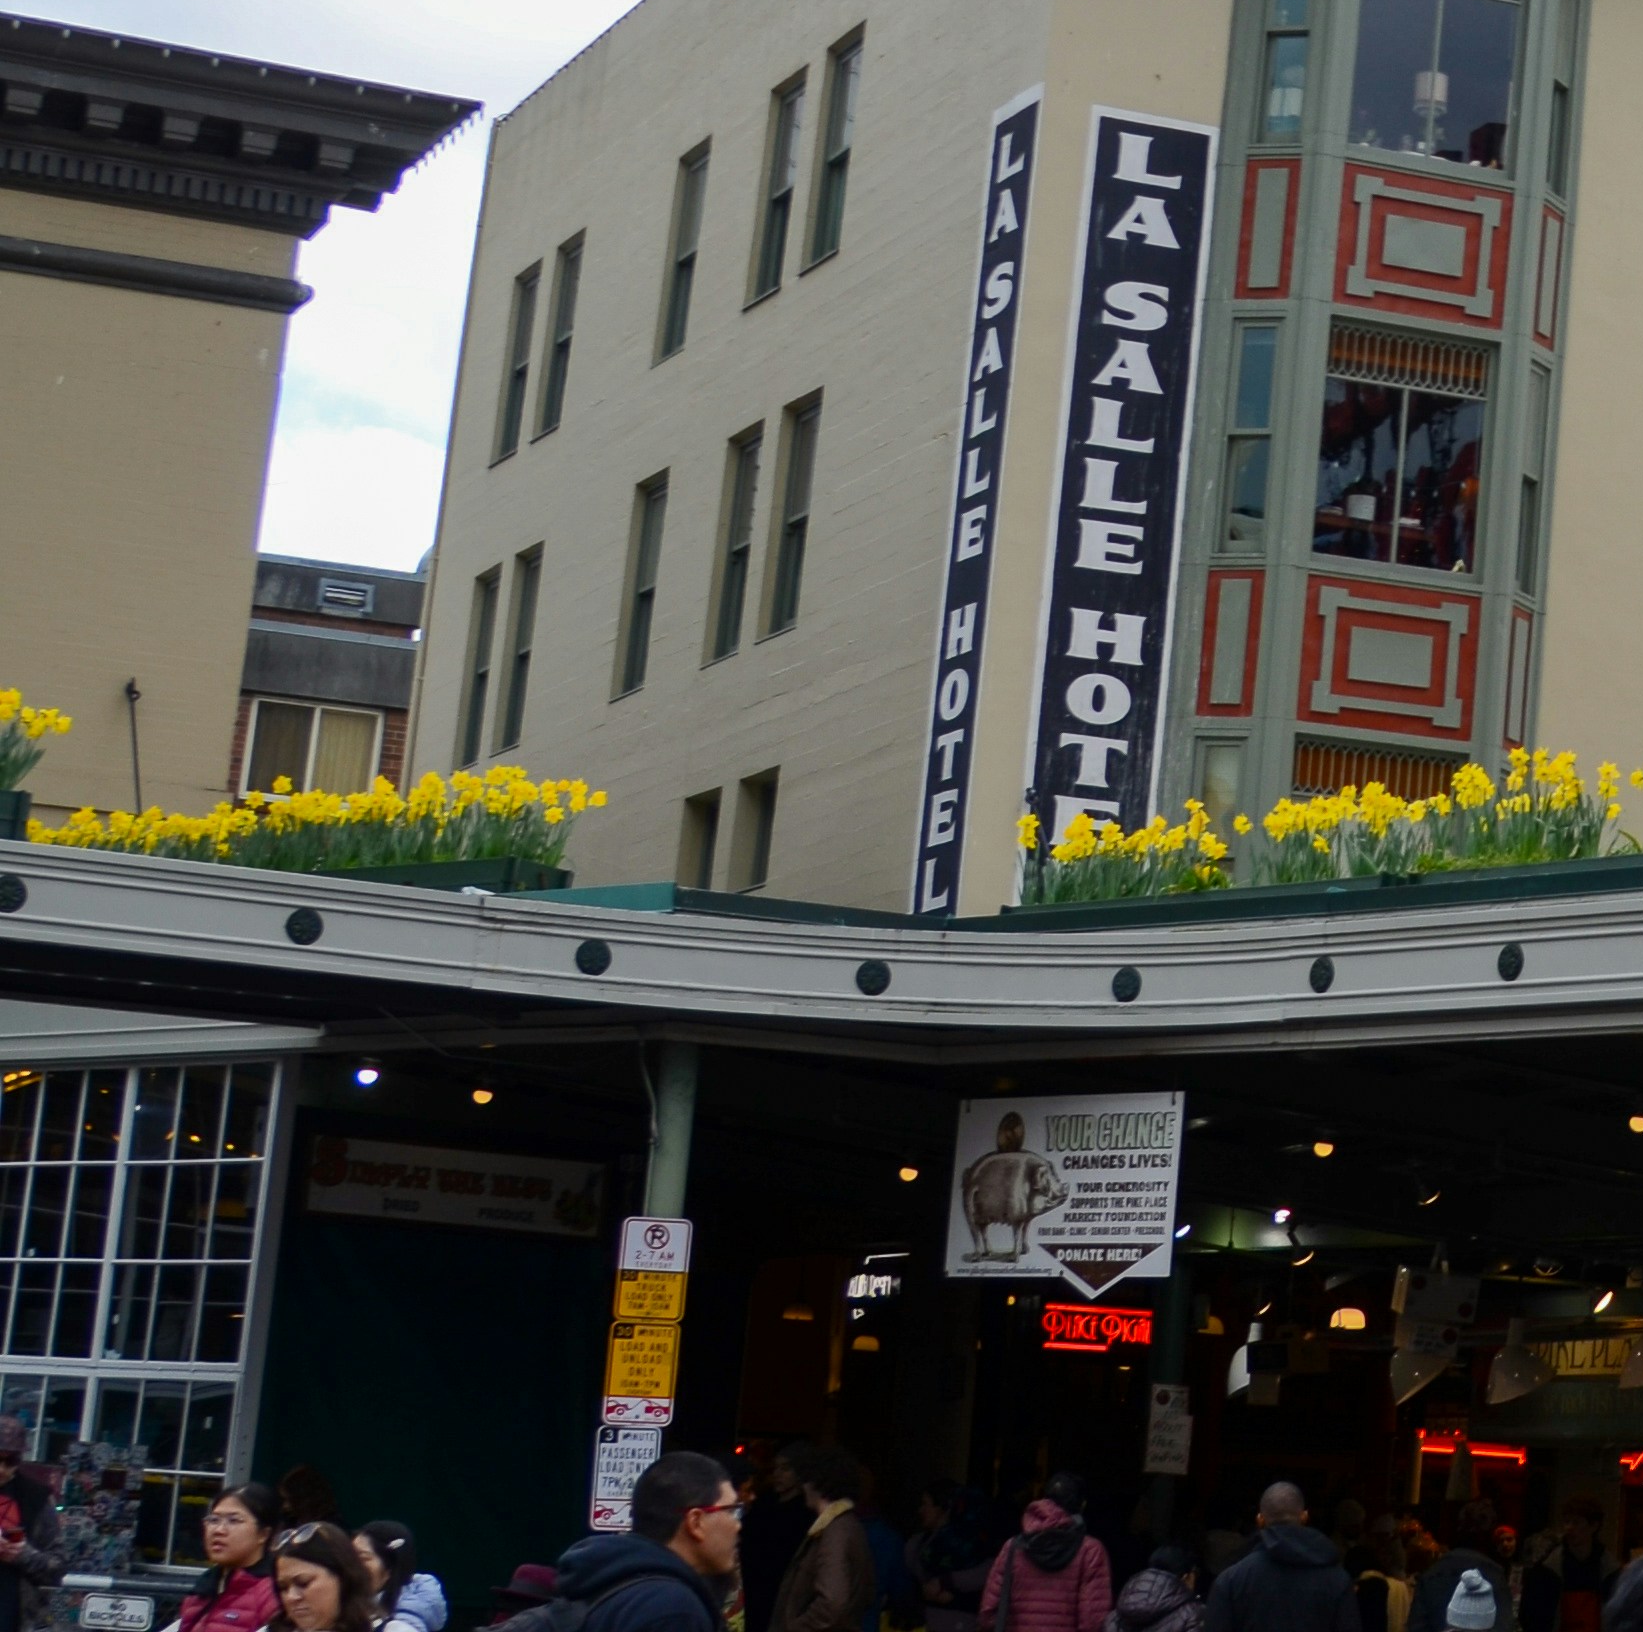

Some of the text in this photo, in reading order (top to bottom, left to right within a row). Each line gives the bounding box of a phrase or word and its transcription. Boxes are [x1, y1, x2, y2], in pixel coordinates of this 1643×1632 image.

[1050, 133, 1182, 846] LA SALLE HOTE
[921, 133, 1025, 913] LA SALLE HOTEL
[1046, 1111, 1177, 1152] YOUR CHANGE
[1063, 1154, 1172, 1169] CHANGES LIVES!
[1076, 1181, 1170, 1193] YOUR GENEROSITY
[1070, 1196, 1168, 1209] SUPPORTS THE PIKE PLACE
[1063, 1211, 1167, 1223] MARKET FOUNDATION
[1057, 1248, 1142, 1262] DONATE HERE!
[620, 1342, 668, 1353] LOAD AND
[622, 1353, 662, 1364] UNLOAD
[629, 1367, 654, 1376] ONLY
[605, 1429, 655, 1441] 3 MINUTE
[602, 1447, 655, 1459] PASSENGER
[600, 1462, 625, 1473] LOAD
[110, 1603, 127, 1612] NO
[88, 1611, 146, 1624] BICYCLES
